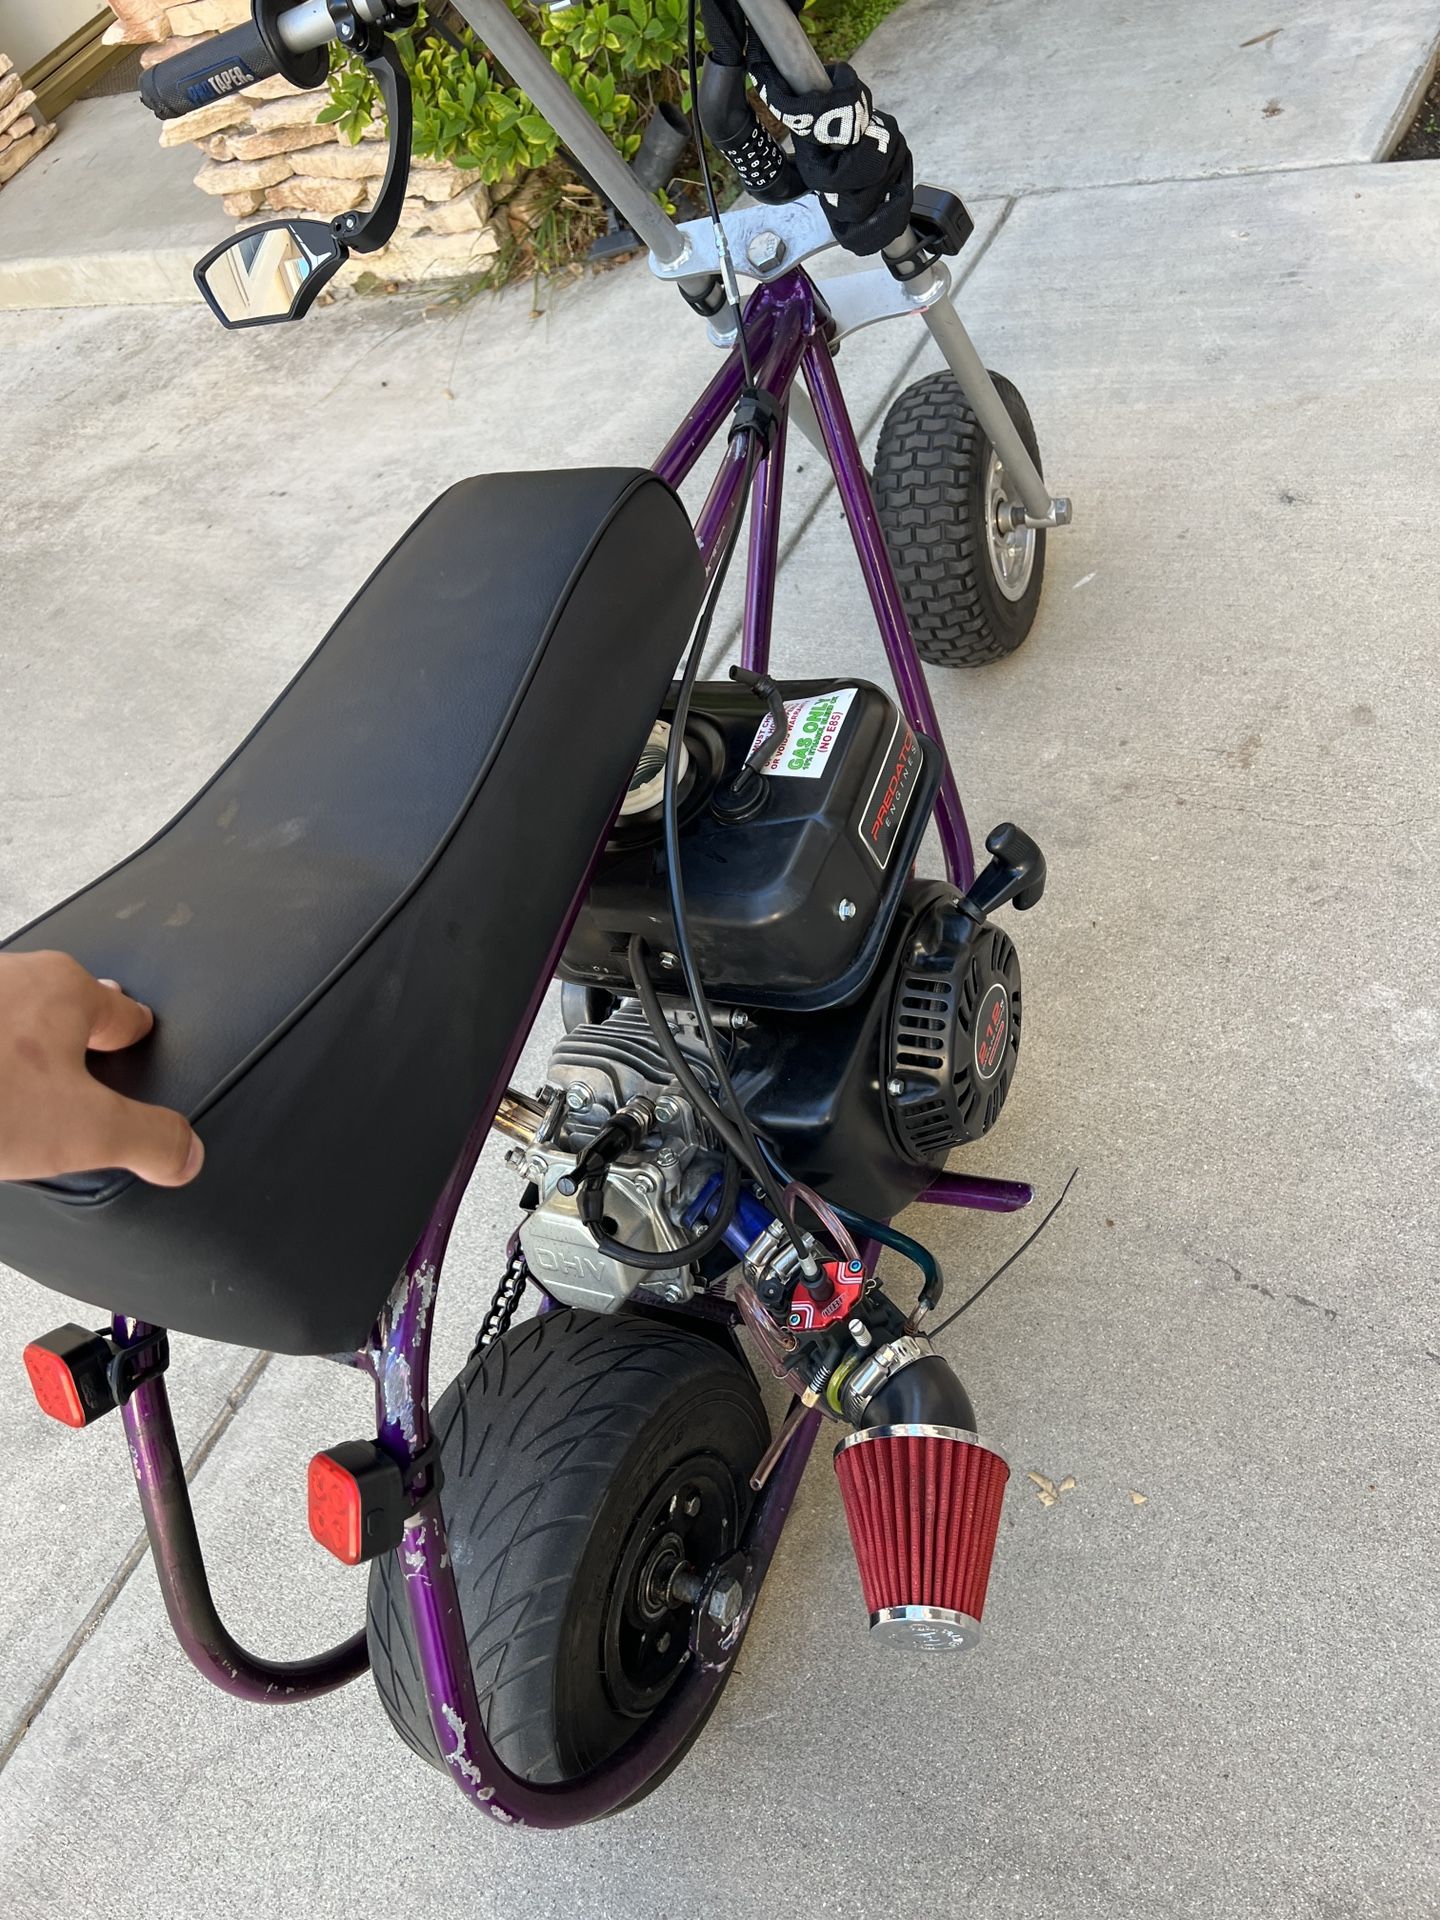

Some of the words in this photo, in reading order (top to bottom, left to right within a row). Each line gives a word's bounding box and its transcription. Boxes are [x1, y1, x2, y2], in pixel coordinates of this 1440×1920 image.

[771, 758, 780, 769] OR
[788, 738, 813, 770] GAS
[803, 698, 831, 733] ONLY
[817, 735, 832, 753] (NO
[827, 712, 843, 732] E85)
[871, 731, 913, 842] PREDATO
[885, 745, 916, 828] ENGINES
